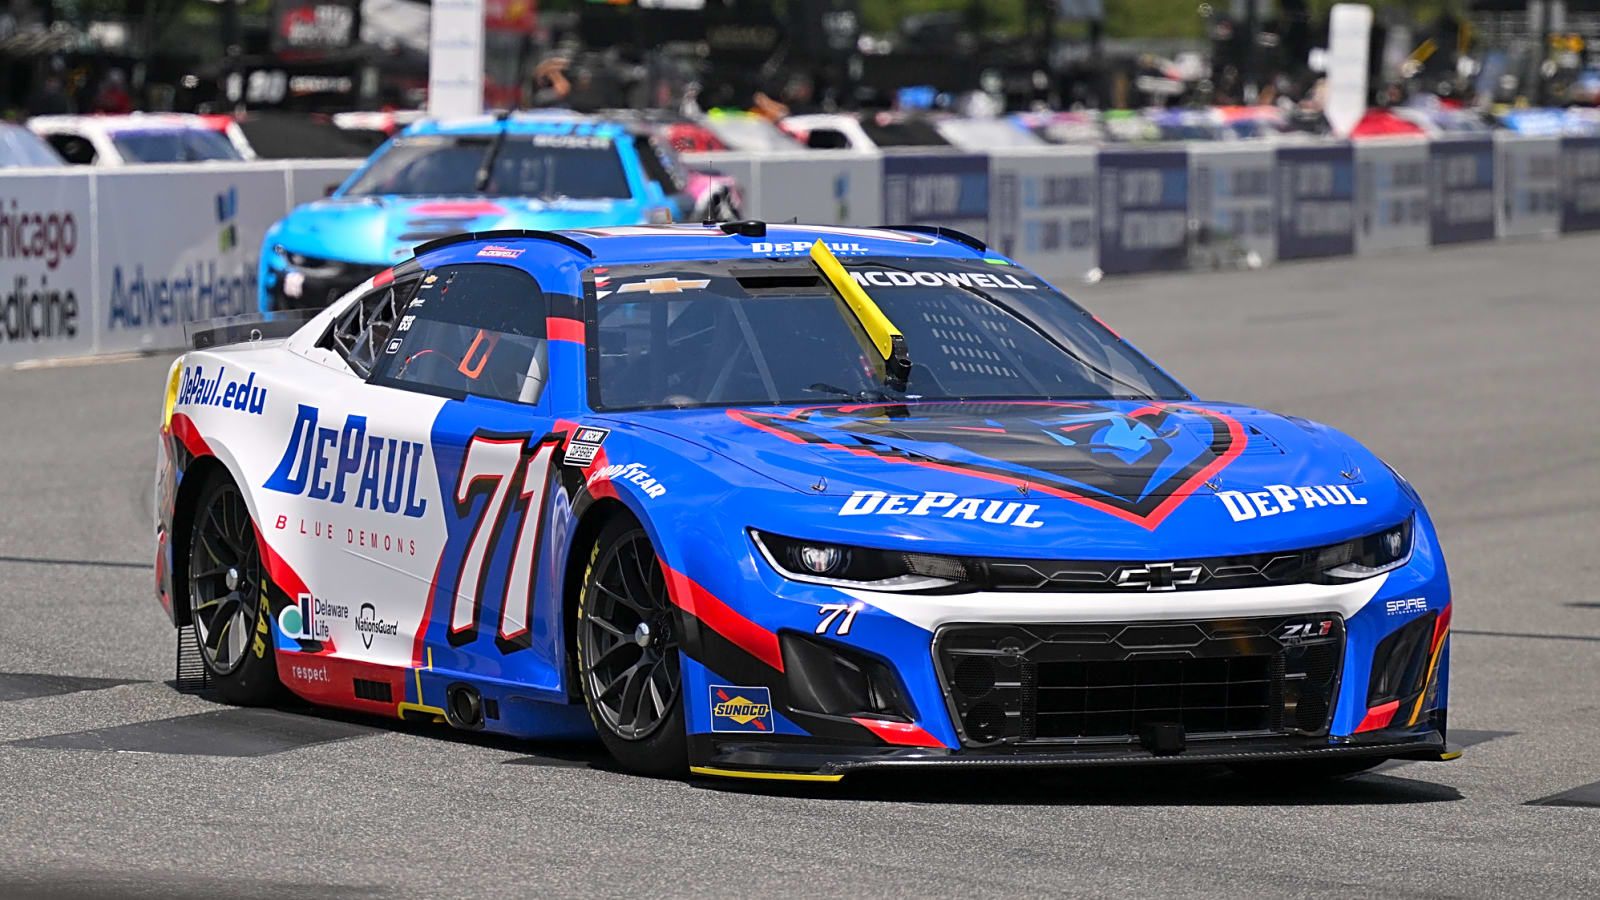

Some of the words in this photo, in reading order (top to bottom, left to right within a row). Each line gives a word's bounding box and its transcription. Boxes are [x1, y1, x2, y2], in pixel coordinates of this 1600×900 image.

[751, 241, 869, 253] DEPUL
[849, 271, 1038, 290] MCDOWELL
[178, 366, 267, 415] DePaul.edu
[586, 463, 667, 499] GOODYEAR
[275, 515, 334, 539] BLUE
[347, 528, 416, 556] DEMONS
[449, 430, 565, 650] 71
[315, 598, 349, 618] Delaware
[1386, 597, 1427, 612] SPIRE
[315, 620, 329, 637] Life
[814, 602, 860, 636] 71
[1278, 620, 1332, 640] ZL1
[292, 665, 331, 683] respect.
[716, 703, 768, 717] SUNOCO
